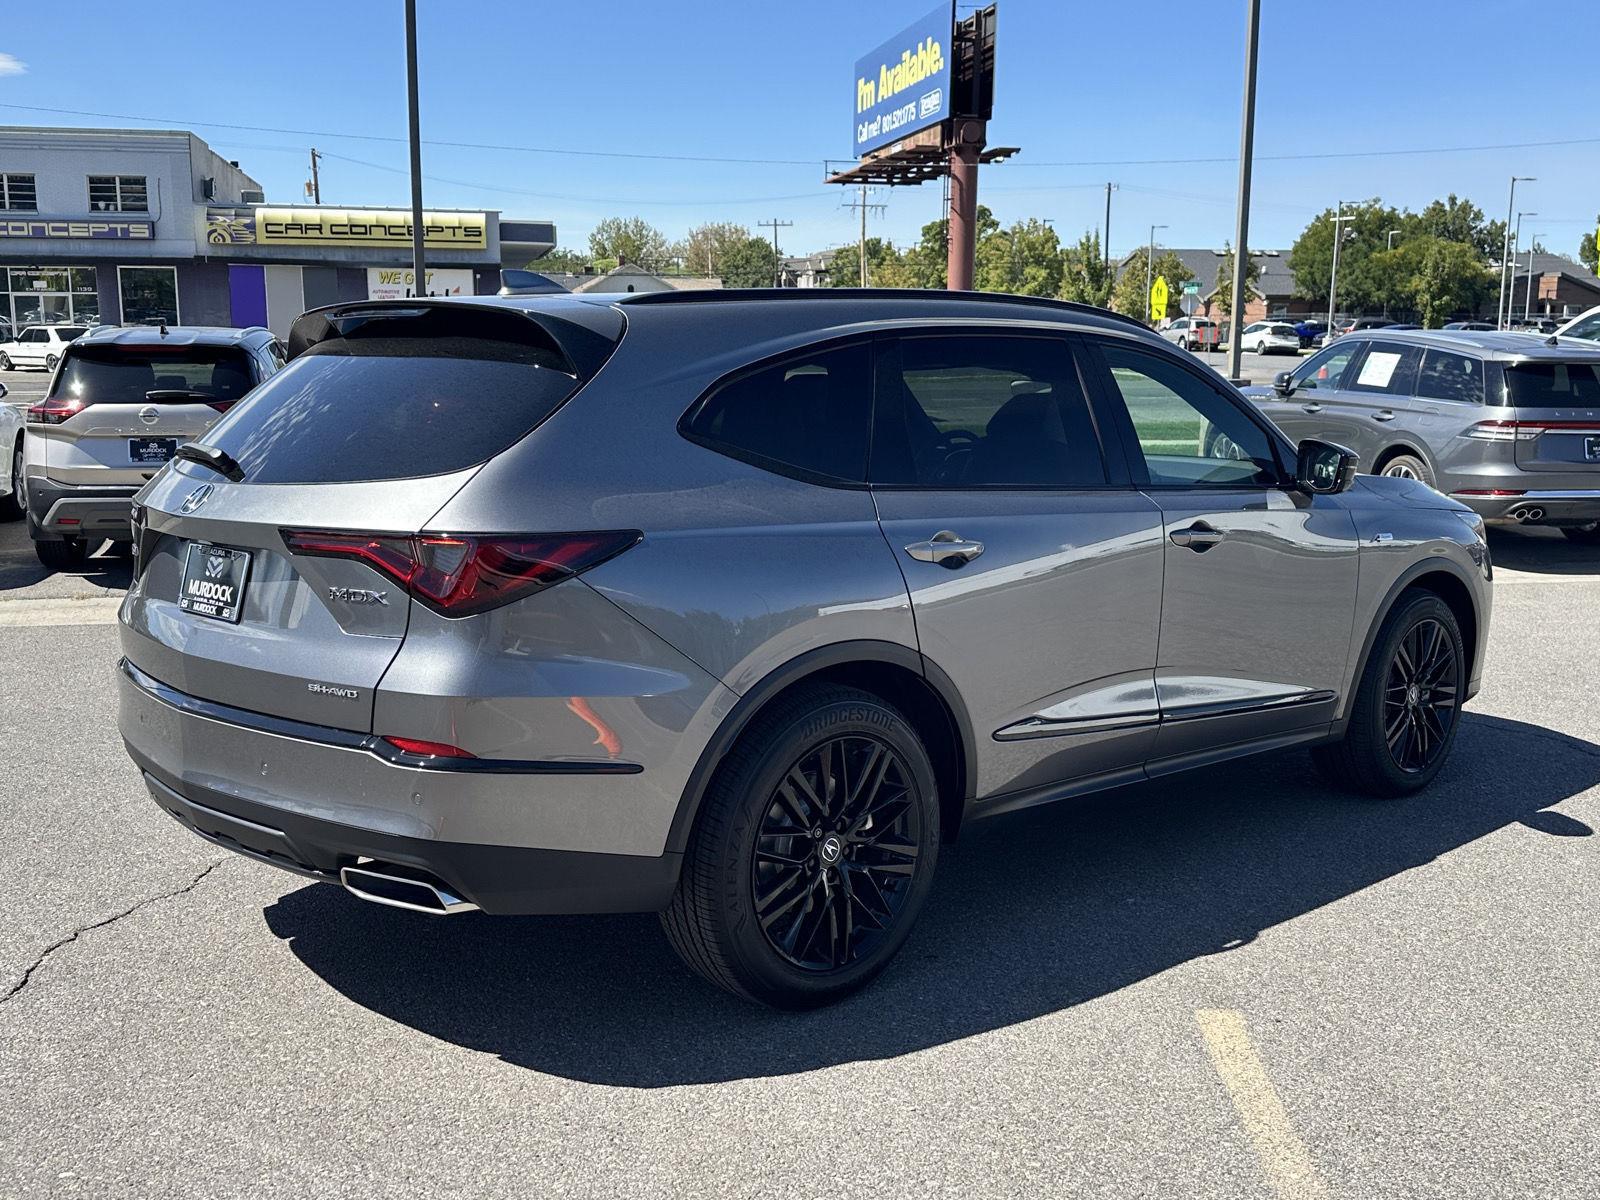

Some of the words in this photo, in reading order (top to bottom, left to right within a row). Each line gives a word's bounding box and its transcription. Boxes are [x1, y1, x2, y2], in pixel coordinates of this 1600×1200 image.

[877, 36, 944, 103] Available.
[857, 122, 869, 144] Call
[265, 223, 323, 234] CAR
[330, 224, 482, 237] CONCEPTS
[379, 271, 401, 285] WE
[404, 271, 434, 285] GT
[210, 548, 226, 557] ACURA
[188, 579, 234, 603] MURDOCK
[329, 586, 390, 605] MDX
[192, 602, 218, 615] MURDOCK
[307, 683, 358, 698] SH-AWD
